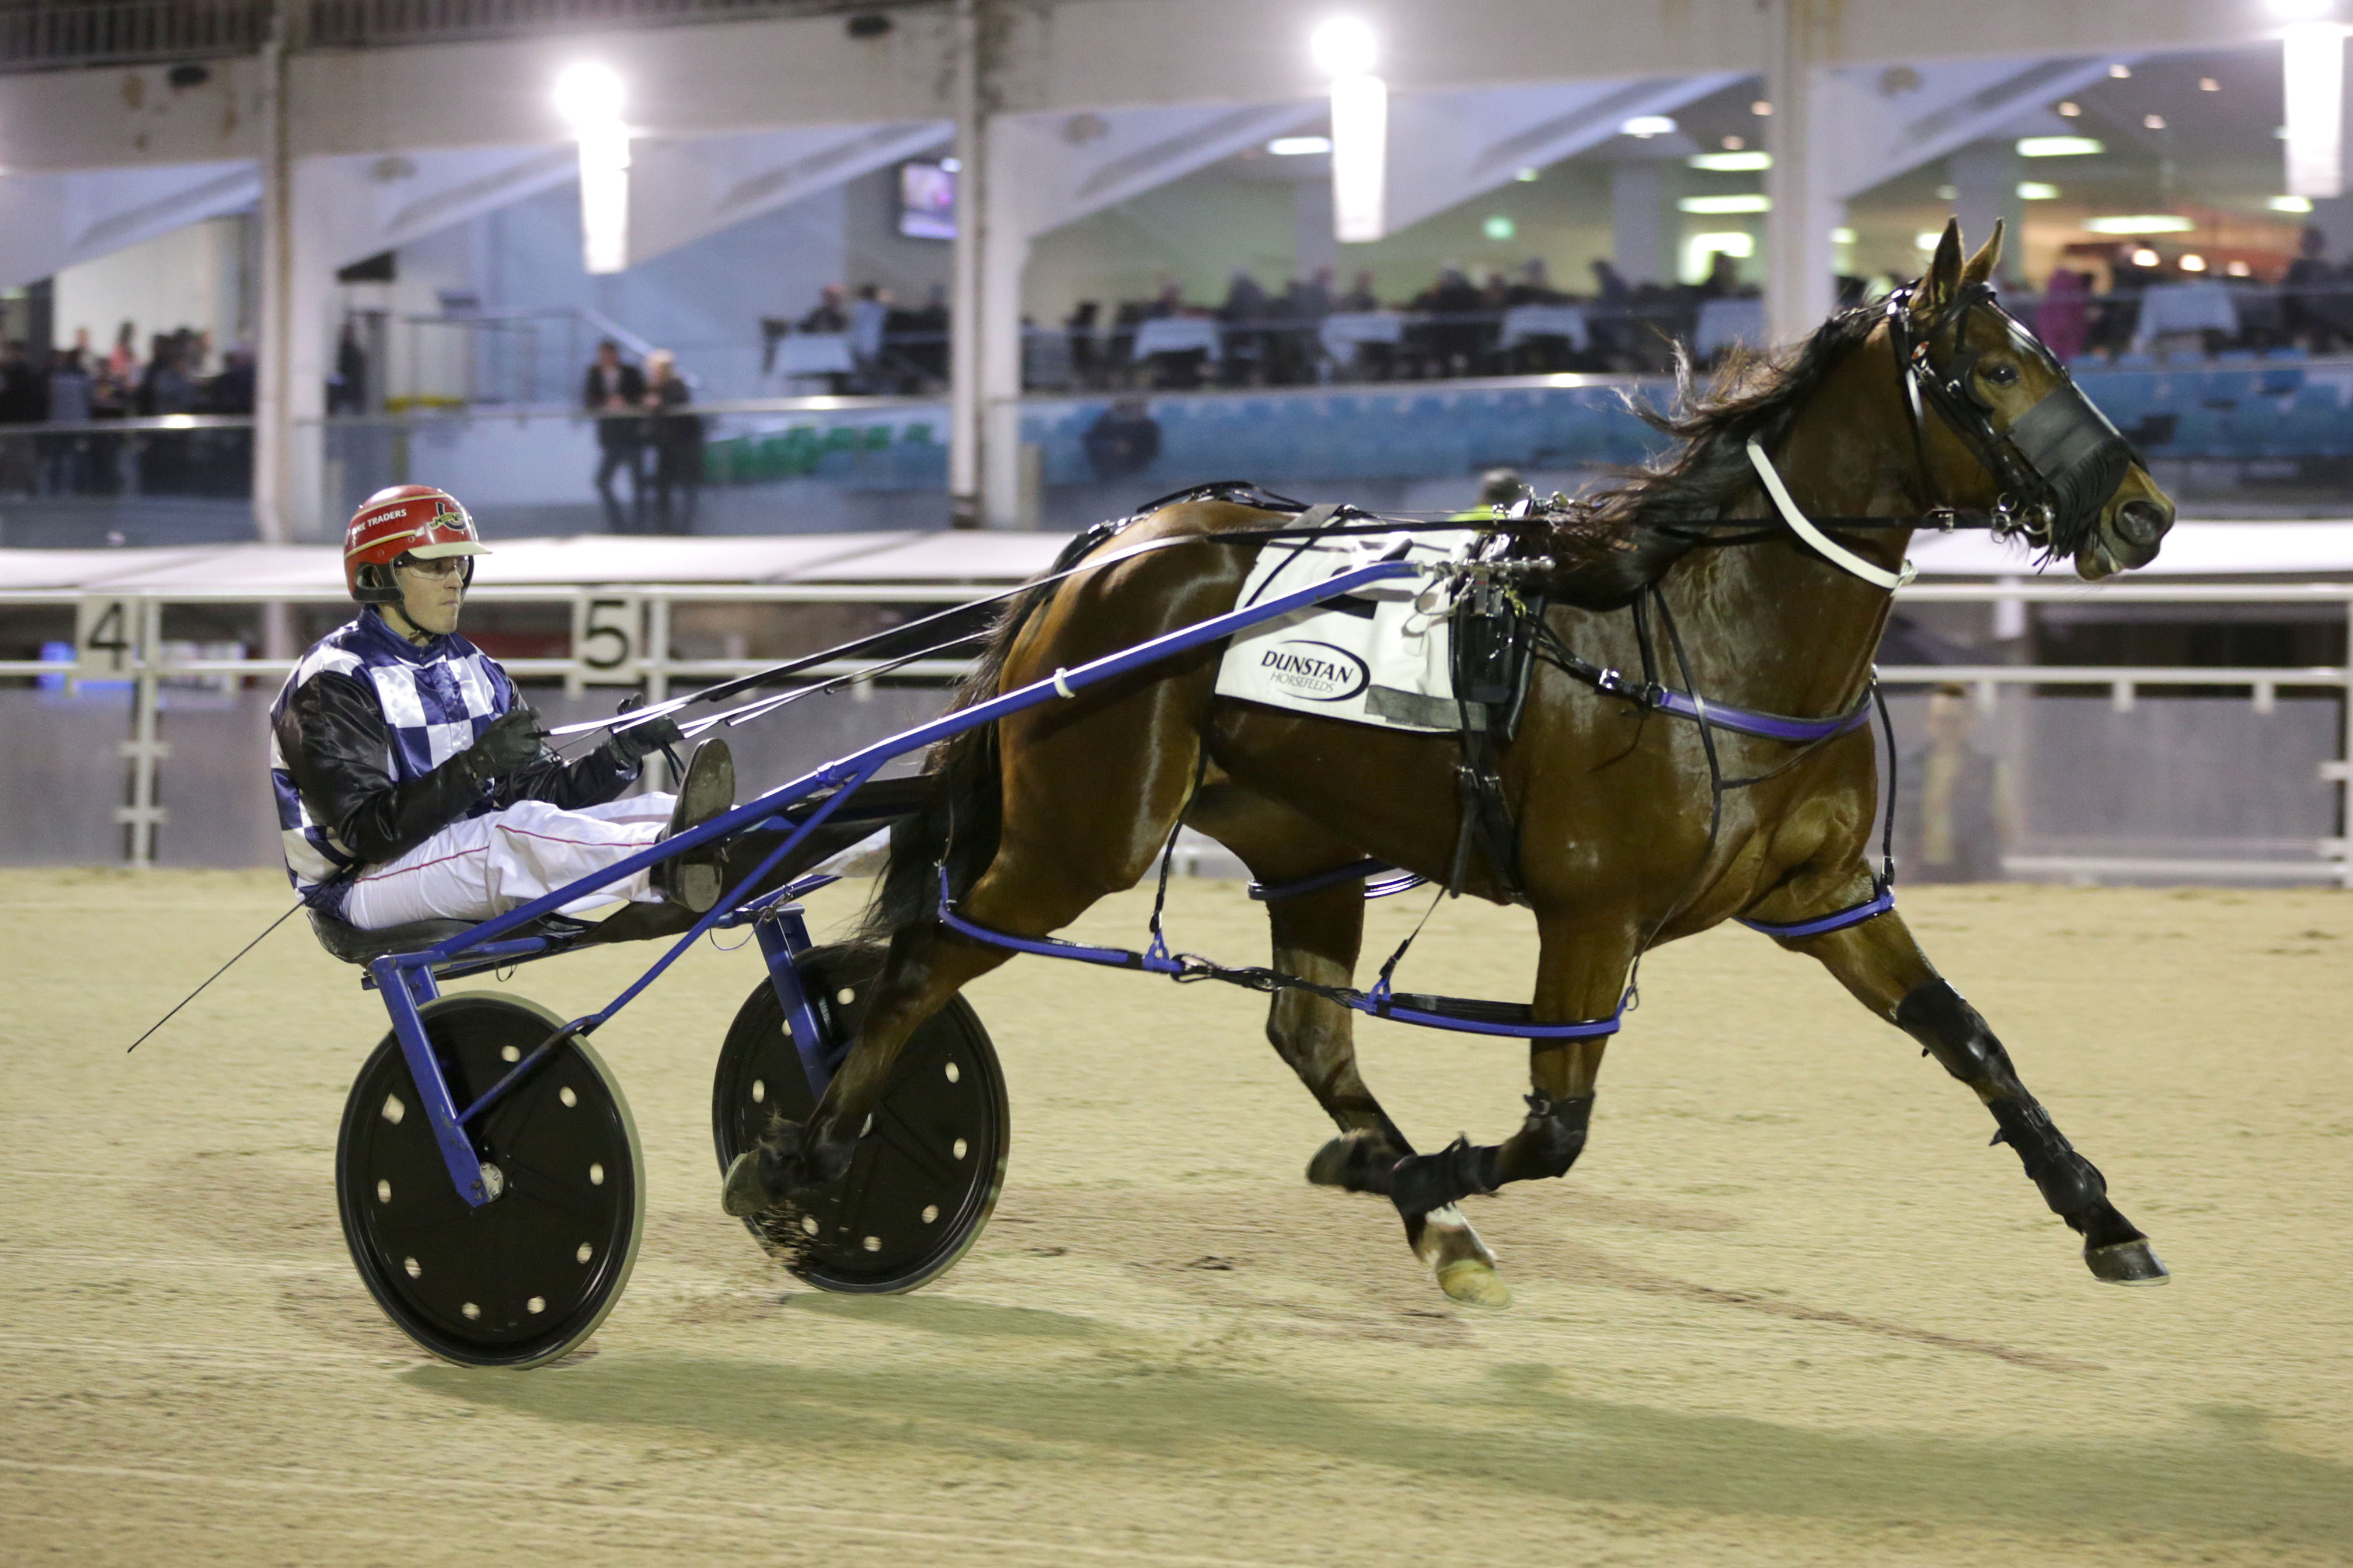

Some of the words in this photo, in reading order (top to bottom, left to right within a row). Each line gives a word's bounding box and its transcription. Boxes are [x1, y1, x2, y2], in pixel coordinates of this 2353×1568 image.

[367, 509, 407, 527] TRADERS
[88, 600, 129, 672] 4
[585, 599, 628, 670] 5
[1261, 651, 1354, 683] DUNSTAN
[1270, 671, 1335, 693] HORSEFEEDS
